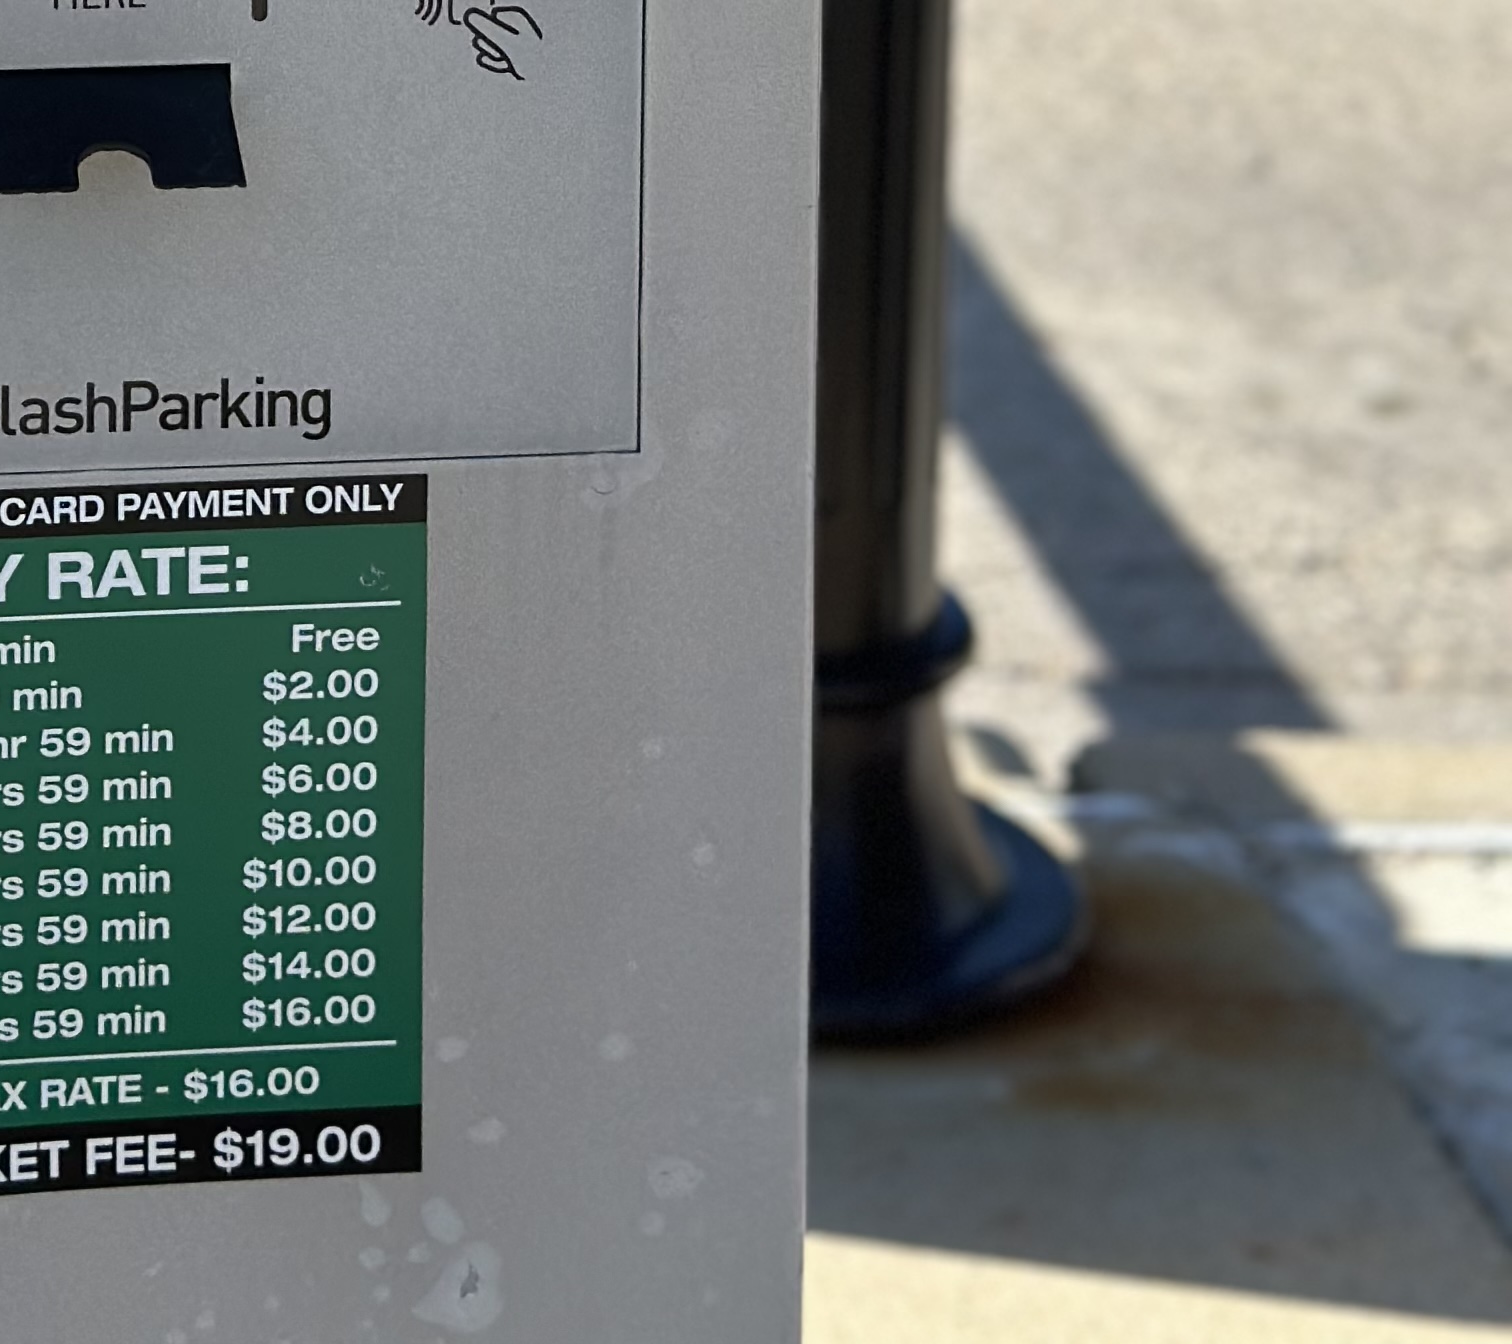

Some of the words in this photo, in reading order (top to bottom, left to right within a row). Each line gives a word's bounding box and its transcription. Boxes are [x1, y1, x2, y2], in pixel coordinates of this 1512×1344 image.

[0, 495, 104, 526] CARD
[118, 488, 294, 520] PAYMENT
[306, 483, 403, 513] ONLY
[49, 546, 248, 599] RATE:
[293, 624, 379, 652] Free
[14, 681, 82, 710] min
[263, 669, 378, 704] $2.00
[40, 727, 90, 757] 59
[106, 724, 173, 754] min
[263, 716, 377, 751] $4.00
[38, 774, 88, 804] 59
[104, 771, 171, 800] min
[262, 762, 377, 798] $6.00
[38, 821, 88, 851] 59
[103, 818, 171, 847] min
[262, 809, 376, 844] $8.00
[38, 868, 88, 897] 59
[103, 864, 170, 894] min
[243, 856, 376, 892] $10.00
[37, 915, 87, 945] 59
[102, 911, 169, 942] min
[243, 902, 375, 938] $12.00
[37, 962, 87, 991] 59
[102, 958, 169, 988] min
[243, 948, 375, 985] $14.00
[33, 1009, 83, 1038] 59
[98, 1005, 165, 1035] min
[243, 995, 375, 1031] $16.00
[41, 1074, 141, 1108] RATE
[184, 1066, 319, 1103] $16.00
[86, 1134, 195, 1175] FEE-
[214, 1125, 380, 1172] $19.00
